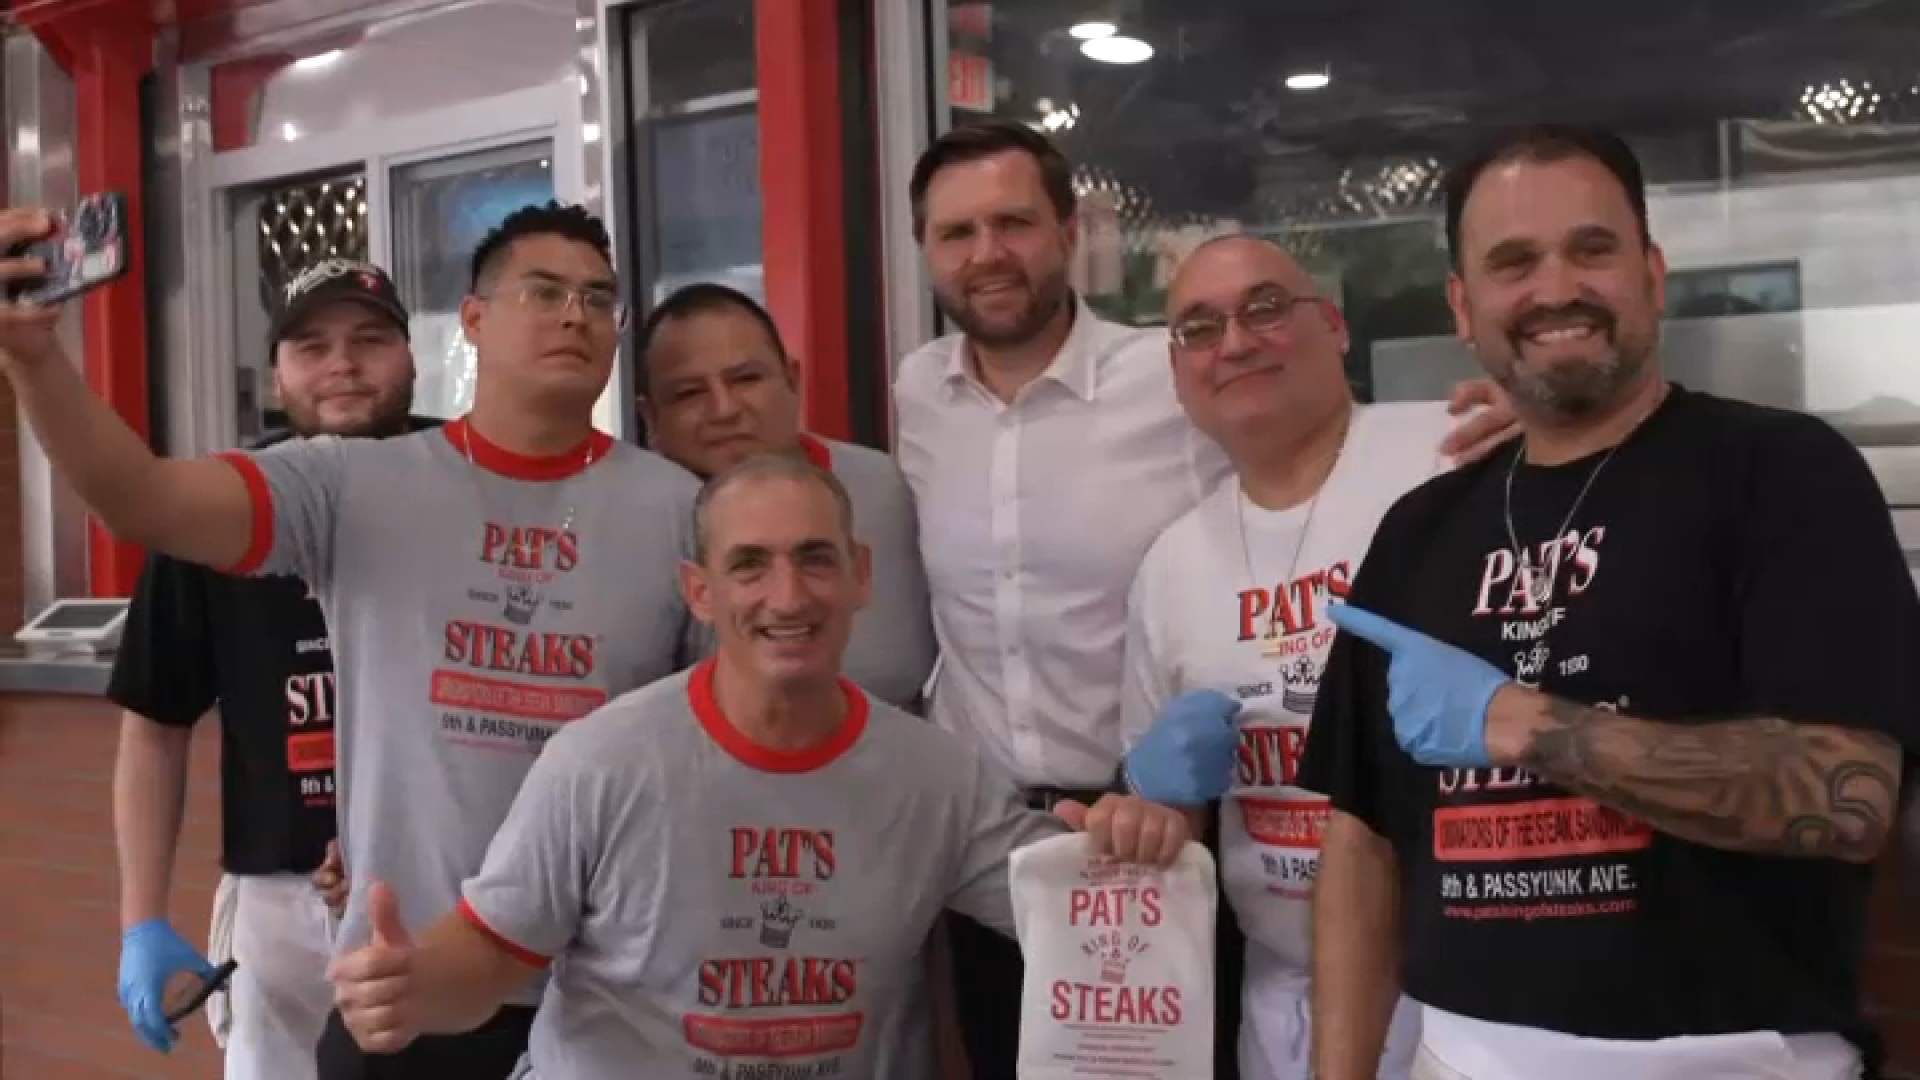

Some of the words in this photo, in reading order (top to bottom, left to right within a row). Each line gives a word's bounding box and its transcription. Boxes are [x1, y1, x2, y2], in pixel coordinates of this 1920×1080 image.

[480, 520, 579, 572] PAT'S
[1472, 526, 1606, 616] PAT'S
[445, 619, 593, 681] STEAKS
[1235, 725, 1308, 787] STE
[728, 827, 837, 881] PAT'S
[1070, 886, 1163, 927] PAT'S
[1466, 873, 1478, 899] &
[1482, 867, 1584, 899] PASSYUNK
[698, 957, 856, 1009] STEAKS
[1050, 979, 1182, 1026] STEAKS
